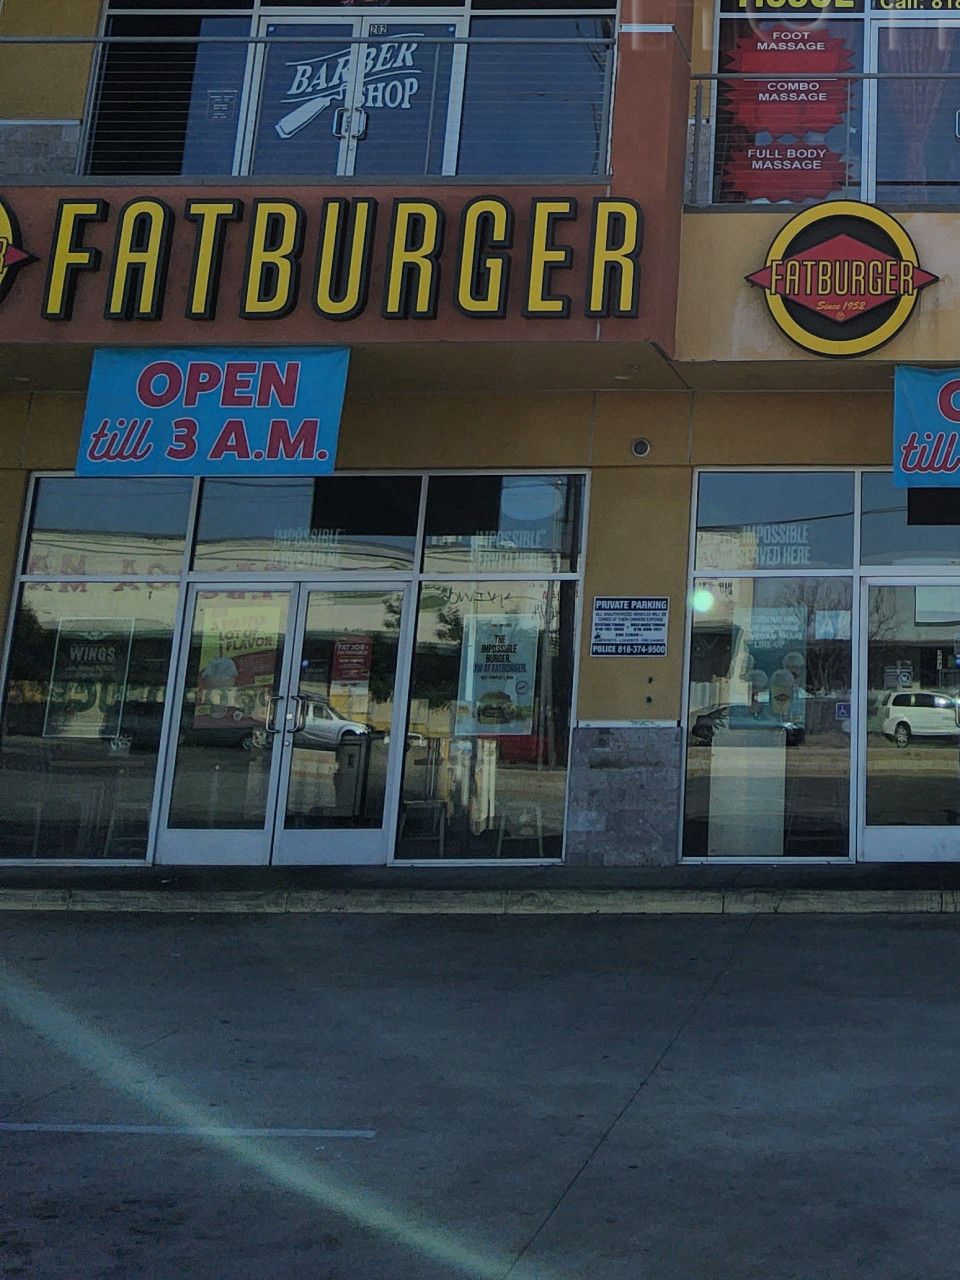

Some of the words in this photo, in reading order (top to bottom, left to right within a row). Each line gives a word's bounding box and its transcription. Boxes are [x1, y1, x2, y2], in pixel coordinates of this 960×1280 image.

[370, 24, 388, 35] 202
[772, 31, 811, 40] FOOT
[757, 42, 826, 51] MASSAGE
[767, 82, 820, 91] COMBO
[758, 93, 828, 102] MASSAGE
[748, 149, 783, 159] FULL
[787, 149, 827, 159] BODY
[751, 160, 822, 170] MASSAGE
[41, 196, 643, 320] FATBURGER
[769, 260, 914, 297] FATBURGER
[816, 301, 841, 311] Since
[842, 301, 866, 310] 1952
[135, 360, 301, 409] OPEN
[88, 417, 154, 463] till
[165, 418, 199, 462] 3
[208, 418, 330, 462] A.M.
[742, 525, 810, 544] IMPOSSIBLE
[782, 546, 812, 565] HERE
[596, 600, 630, 609] PRIVATE
[631, 600, 667, 609] PARKING
[593, 645, 616, 653] POLICE
